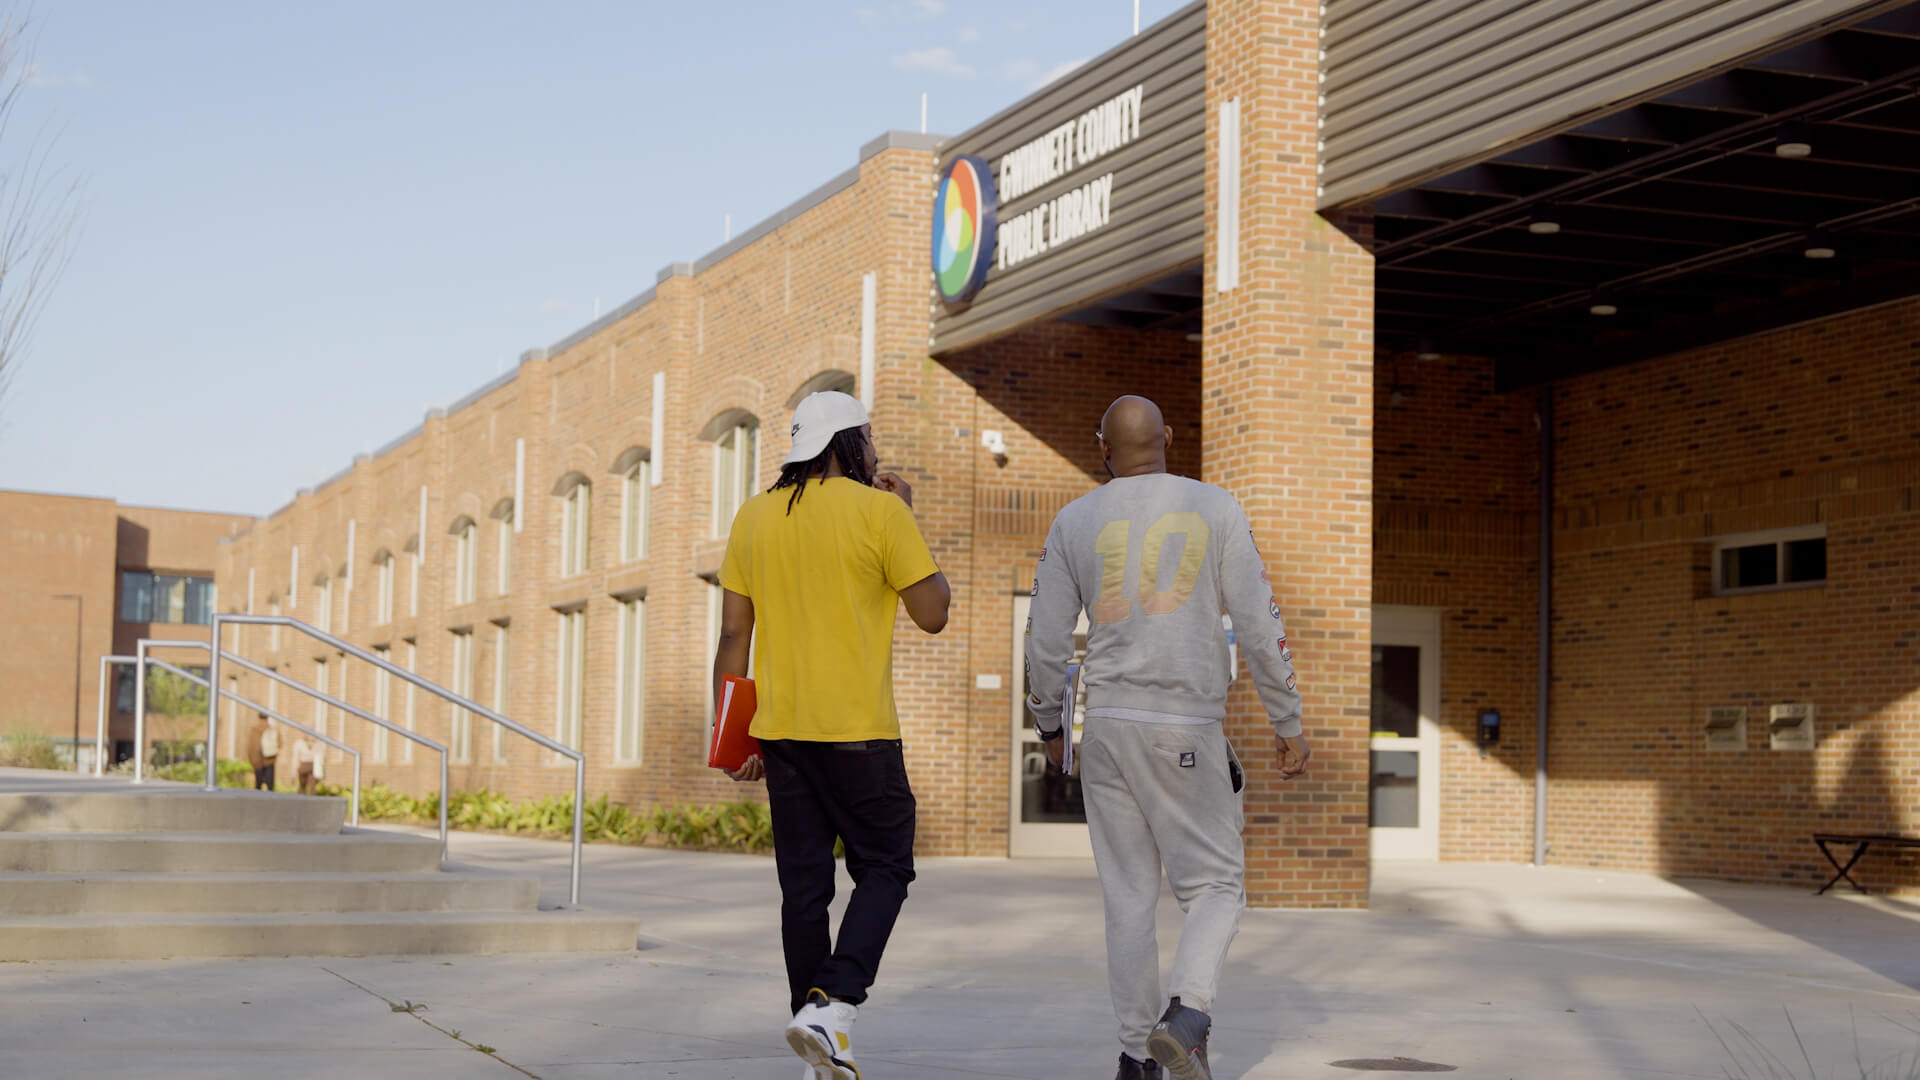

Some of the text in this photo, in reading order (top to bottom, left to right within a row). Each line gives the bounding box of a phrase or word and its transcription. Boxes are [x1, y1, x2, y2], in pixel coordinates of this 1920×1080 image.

[1001, 84, 1143, 203] GWINNETT COUNTY
[998, 172, 1113, 270] PUBLIC LIBRARY
[1094, 511, 1211, 624] 10
